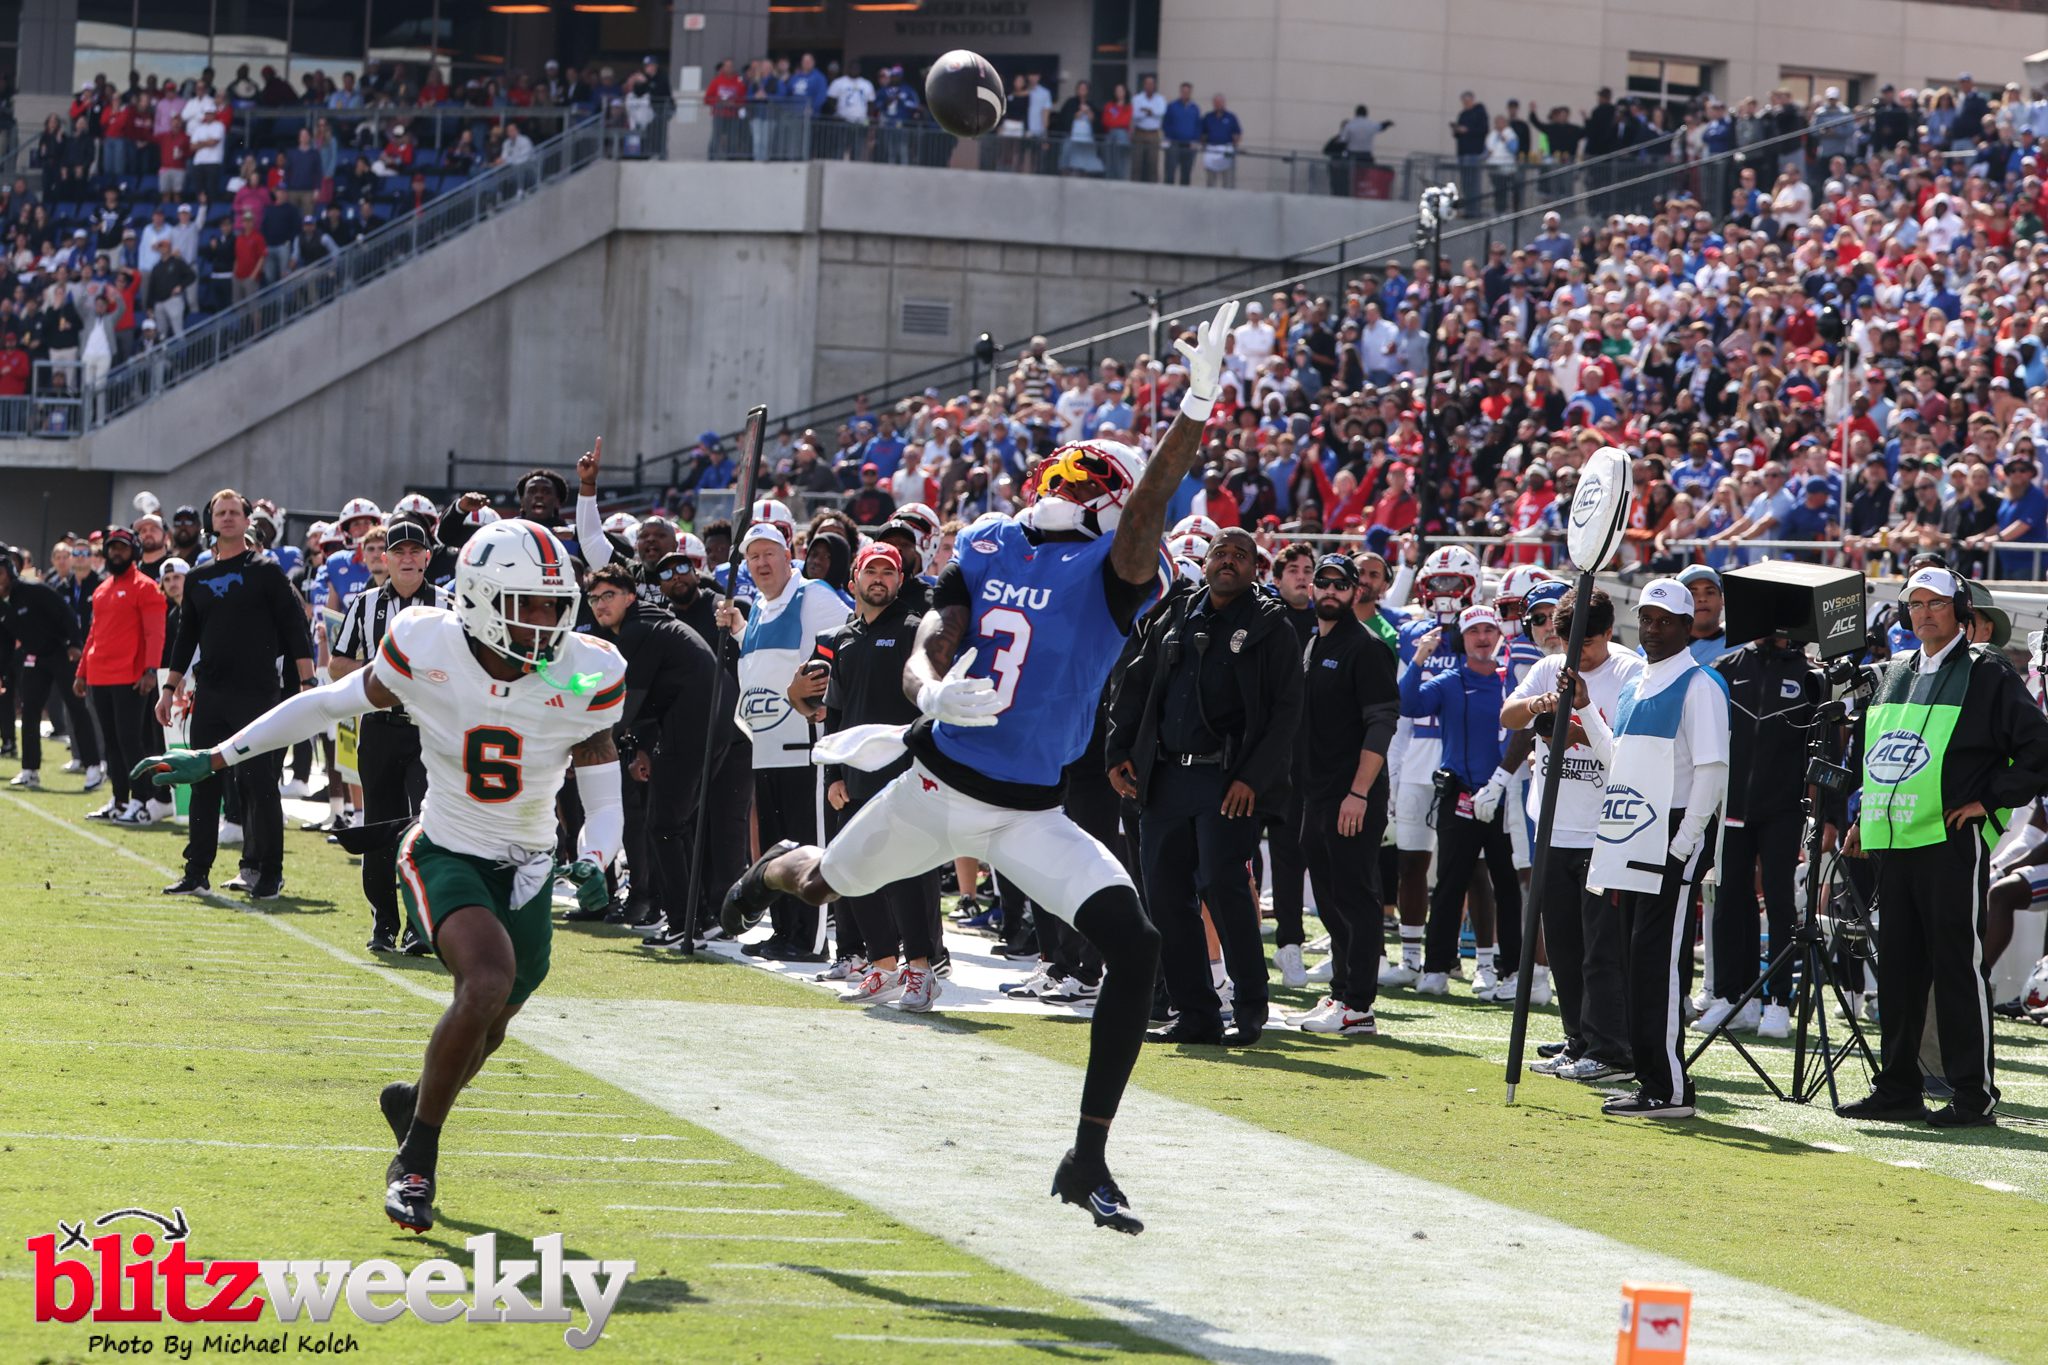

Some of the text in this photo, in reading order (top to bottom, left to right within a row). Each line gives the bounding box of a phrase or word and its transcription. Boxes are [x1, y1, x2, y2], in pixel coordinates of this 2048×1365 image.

[1575, 487, 1600, 508] ACC
[464, 540, 495, 567] U
[737, 584, 760, 596] SM
[982, 579, 1052, 610] SMU
[376, 609, 385, 619] S
[1829, 614, 1857, 635] ACC
[966, 605, 1032, 715] 3
[490, 683, 510, 698] U
[745, 696, 779, 714] ACC
[1542, 754, 1605, 771] CPETITIVE
[1872, 743, 1924, 763] ACC
[463, 724, 524, 803] 6
[1541, 766, 1582, 780] CERAS
[1601, 799, 1646, 820] ACC
[1864, 792, 1919, 808] STANT
